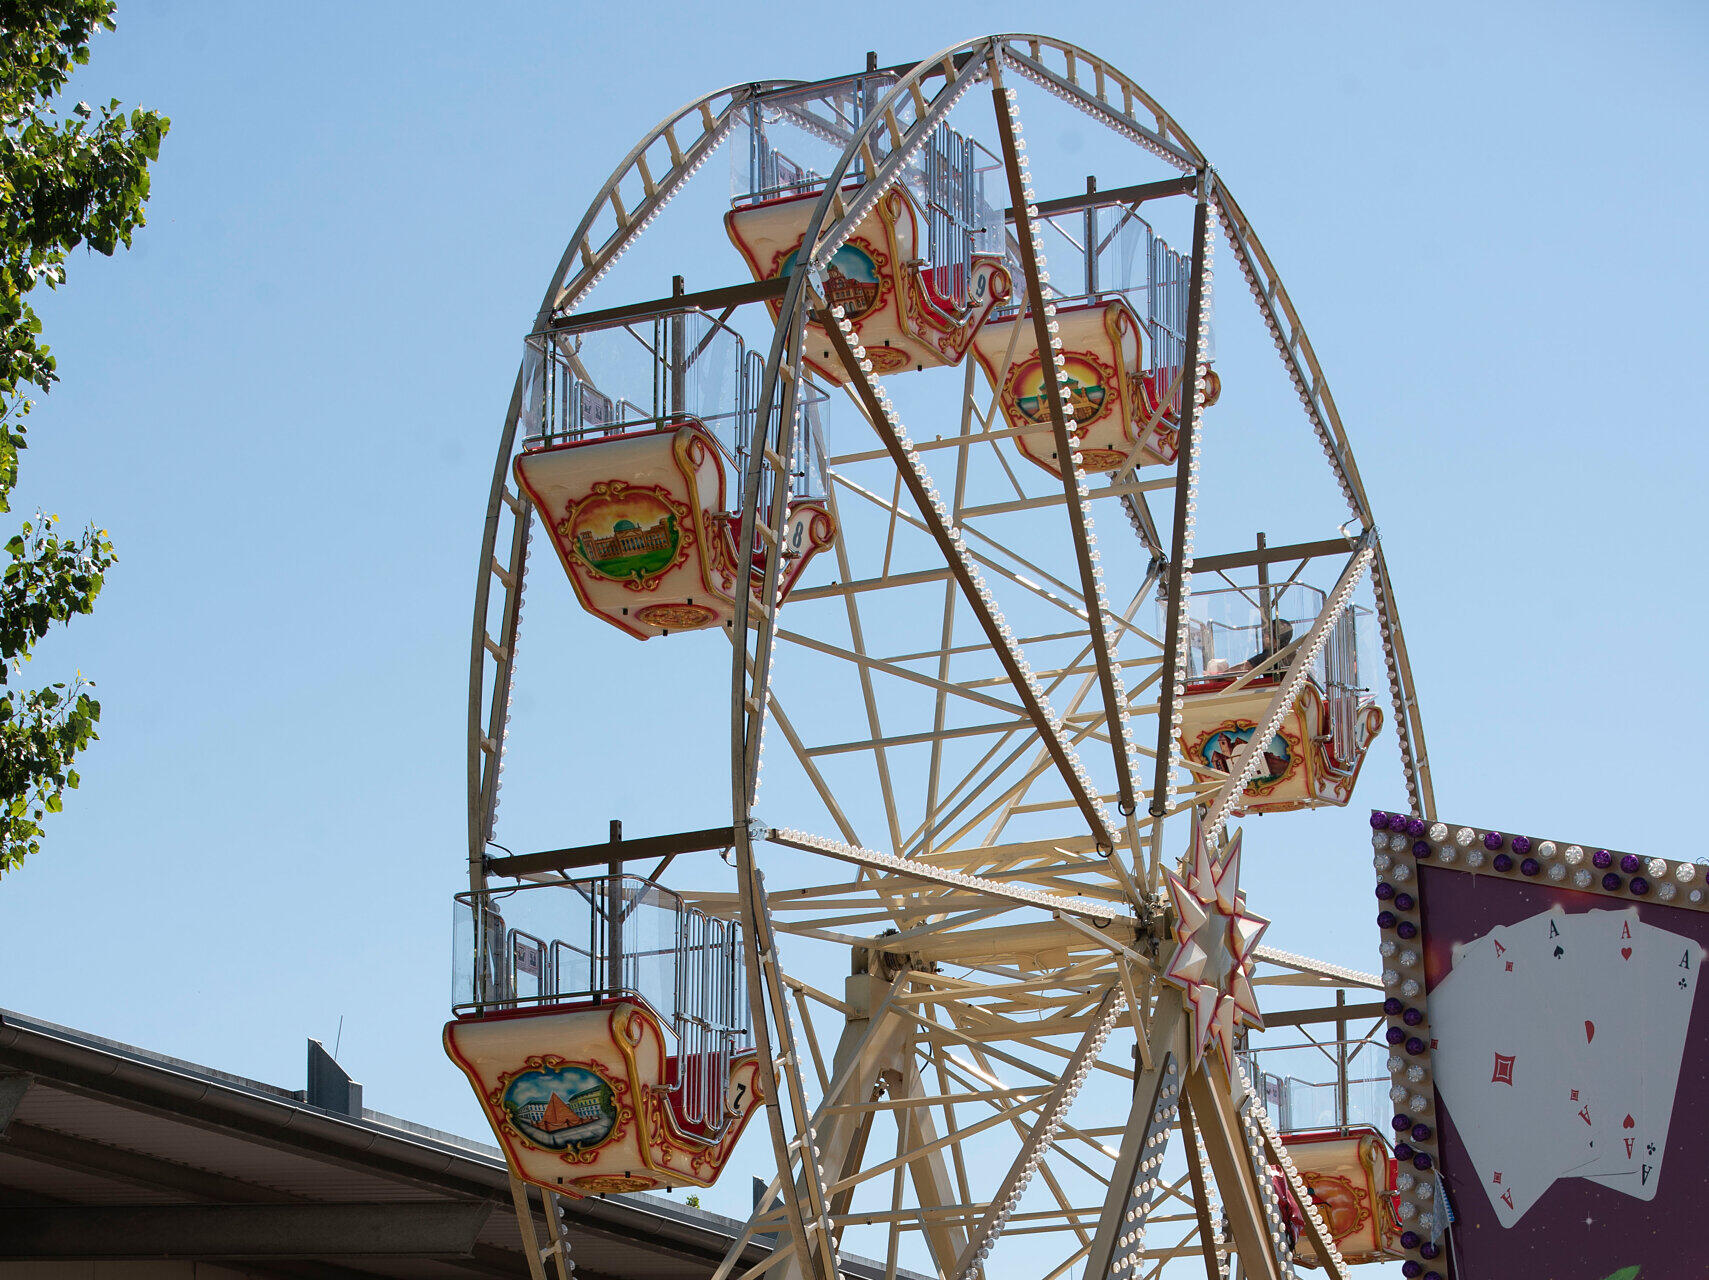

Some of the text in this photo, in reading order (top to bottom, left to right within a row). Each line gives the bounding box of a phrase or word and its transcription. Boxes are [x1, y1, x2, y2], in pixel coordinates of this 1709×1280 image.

[976, 273, 987, 298] 9
[792, 520, 804, 549] 8
[1549, 918, 1560, 939] A
[1620, 919, 1632, 939] A
[1494, 938, 1507, 959] A
[1678, 948, 1690, 970] A
[733, 1082, 746, 1110] 7
[1578, 1104, 1592, 1127] A
[1623, 1137, 1636, 1160] A
[1641, 1163, 1653, 1186] A
[1500, 1187, 1514, 1211] A
